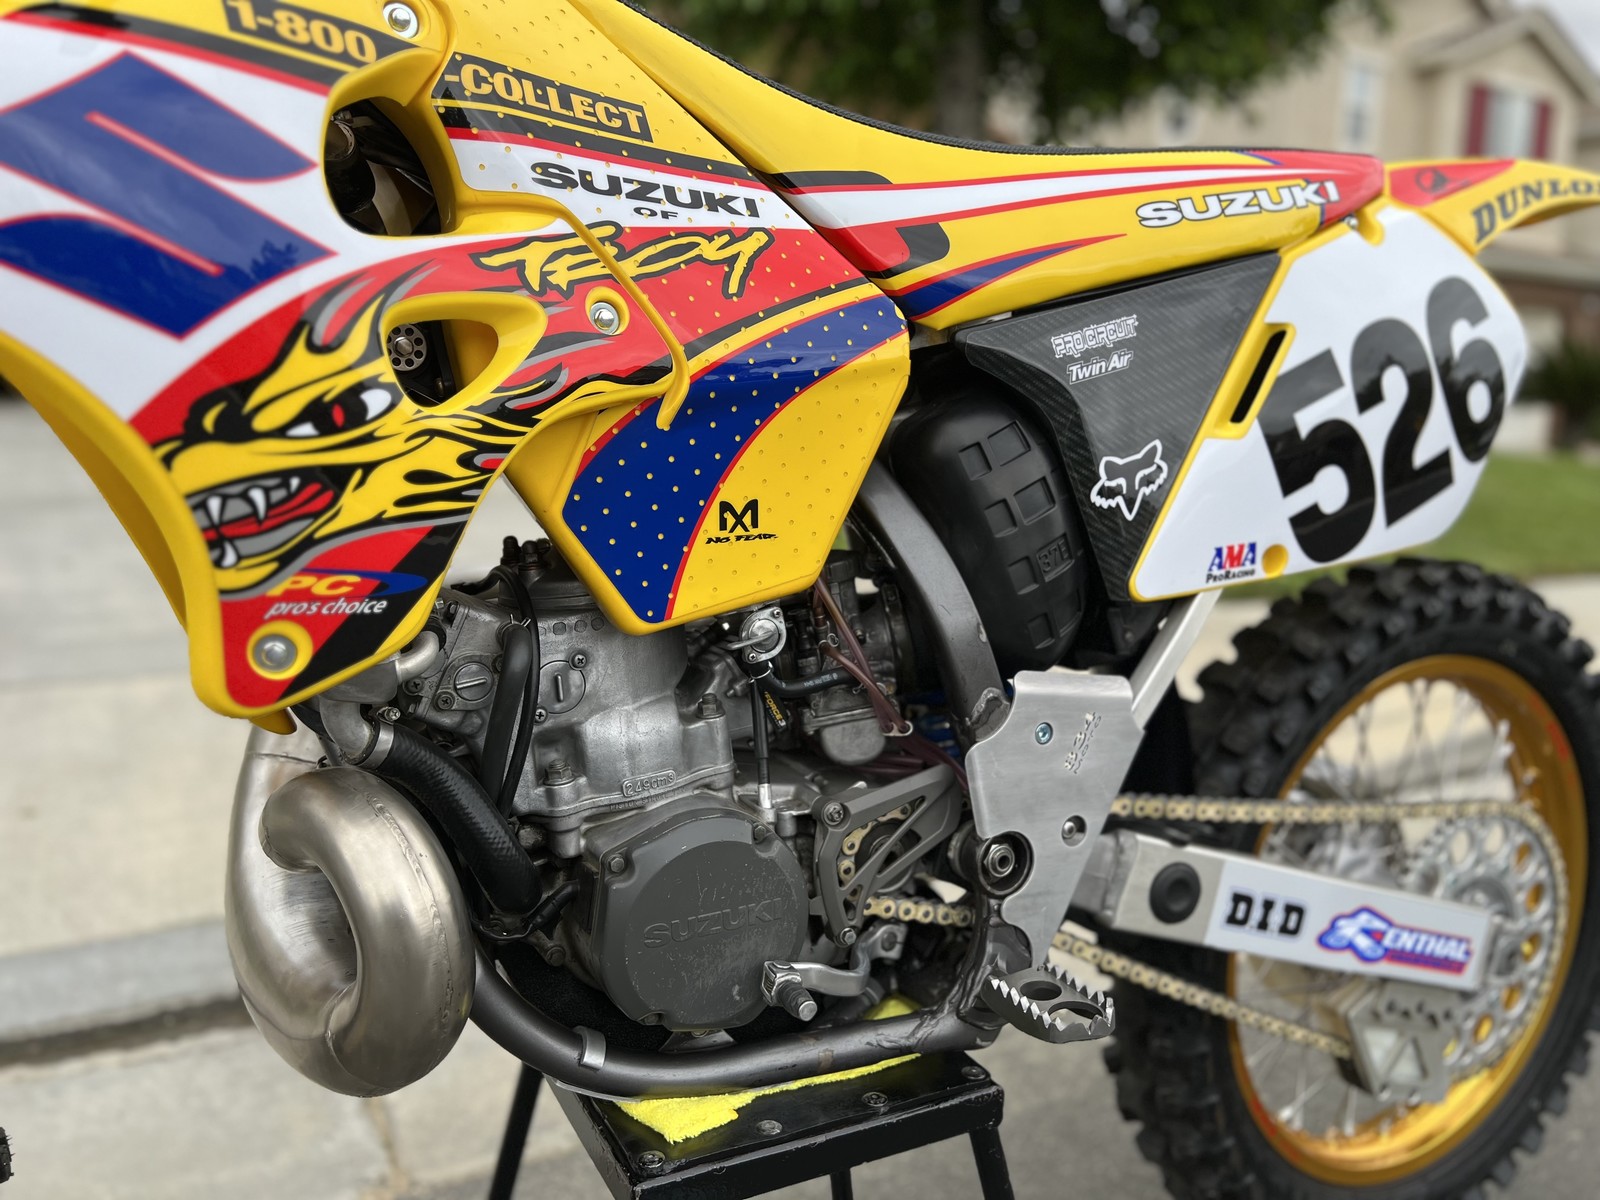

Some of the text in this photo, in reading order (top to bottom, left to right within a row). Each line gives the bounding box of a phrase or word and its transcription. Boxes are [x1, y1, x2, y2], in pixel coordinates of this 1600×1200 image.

[226, 0, 377, 64] 1-800
[531, 161, 761, 218] SUZUKI
[1136, 180, 1341, 228] SUZUKI
[1472, 179, 1600, 244] DUNLO
[633, 207, 679, 220] OF
[1051, 314, 1138, 358] PRO CIRCUIT
[1068, 351, 1132, 383] Twin Air
[1257, 276, 1507, 563] 526
[705, 536, 731, 544] NO
[1208, 542, 1257, 571] AMA
[265, 574, 362, 597] PC
[264, 597, 388, 620] pro's choice
[643, 897, 782, 948] SUZUKI
